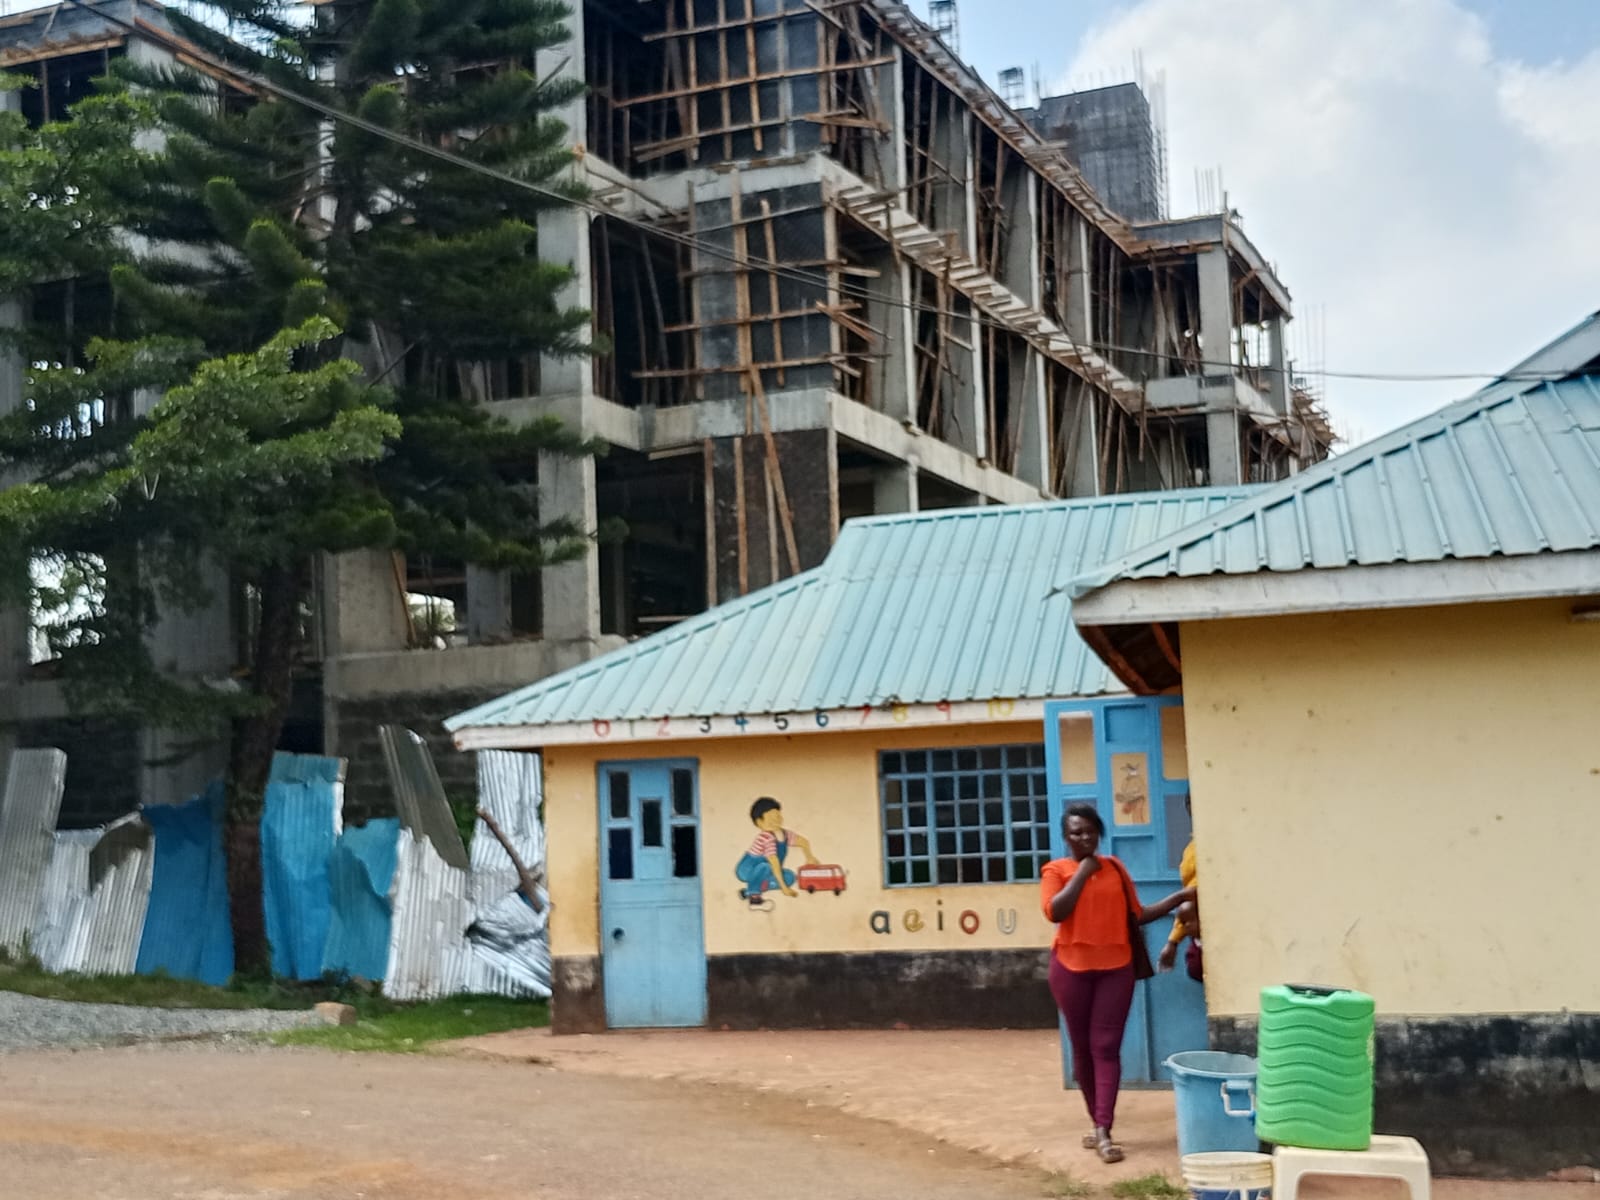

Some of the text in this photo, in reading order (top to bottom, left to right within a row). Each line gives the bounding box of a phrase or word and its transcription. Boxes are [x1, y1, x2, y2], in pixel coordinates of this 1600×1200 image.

[698, 716, 712, 733] 3
[774, 712, 789, 730] 5
[815, 708, 829, 727] 6
[857, 704, 872, 724] 7
[987, 699, 1015, 719] 10
[936, 899, 944, 931] i
